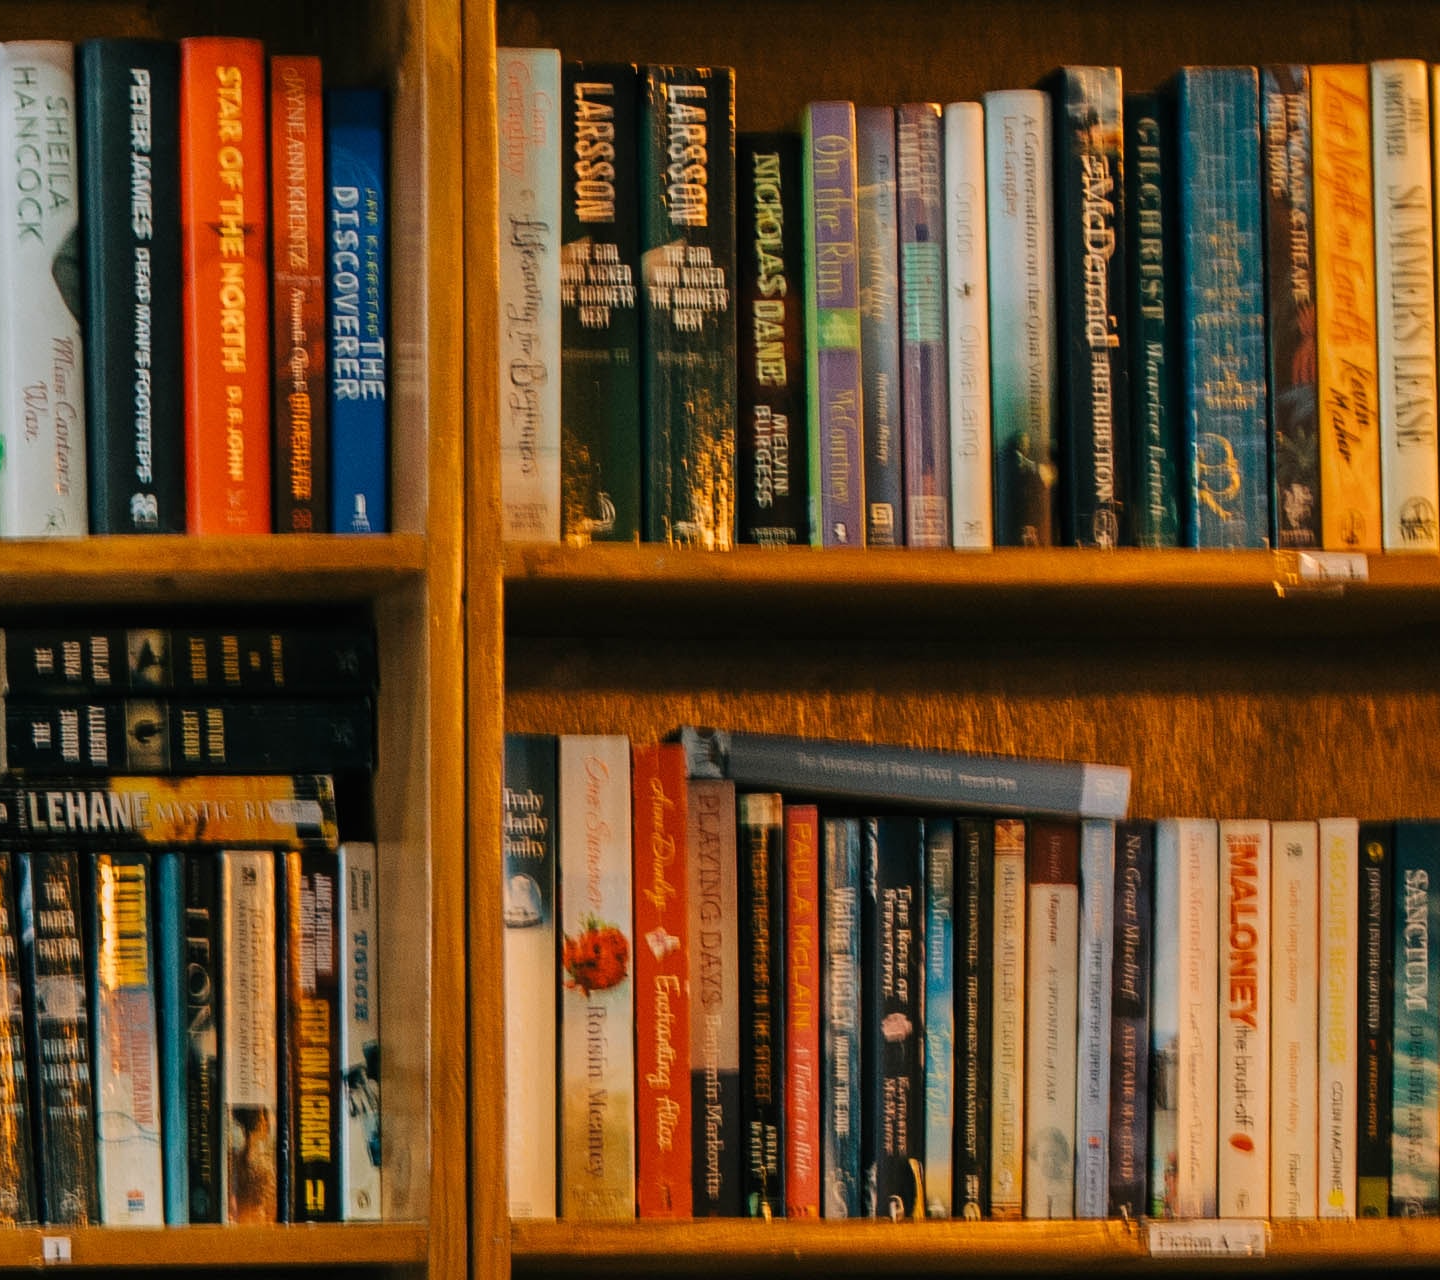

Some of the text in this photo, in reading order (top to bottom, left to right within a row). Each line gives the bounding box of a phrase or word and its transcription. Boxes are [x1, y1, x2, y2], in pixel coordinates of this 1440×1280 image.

[14, 66, 42, 242] HANCOCK
[44, 97, 70, 211] SHEILA
[131, 69, 150, 240] PETER JAMES
[217, 66, 244, 372] STAR OF THE NORTH
[667, 85, 708, 226] LARSSON
[332, 187, 358, 399] DISCOVERER
[361, 337, 384, 399] THE
[28, 791, 153, 833] LEHANE
[1229, 850, 1258, 1028] MALONEY
